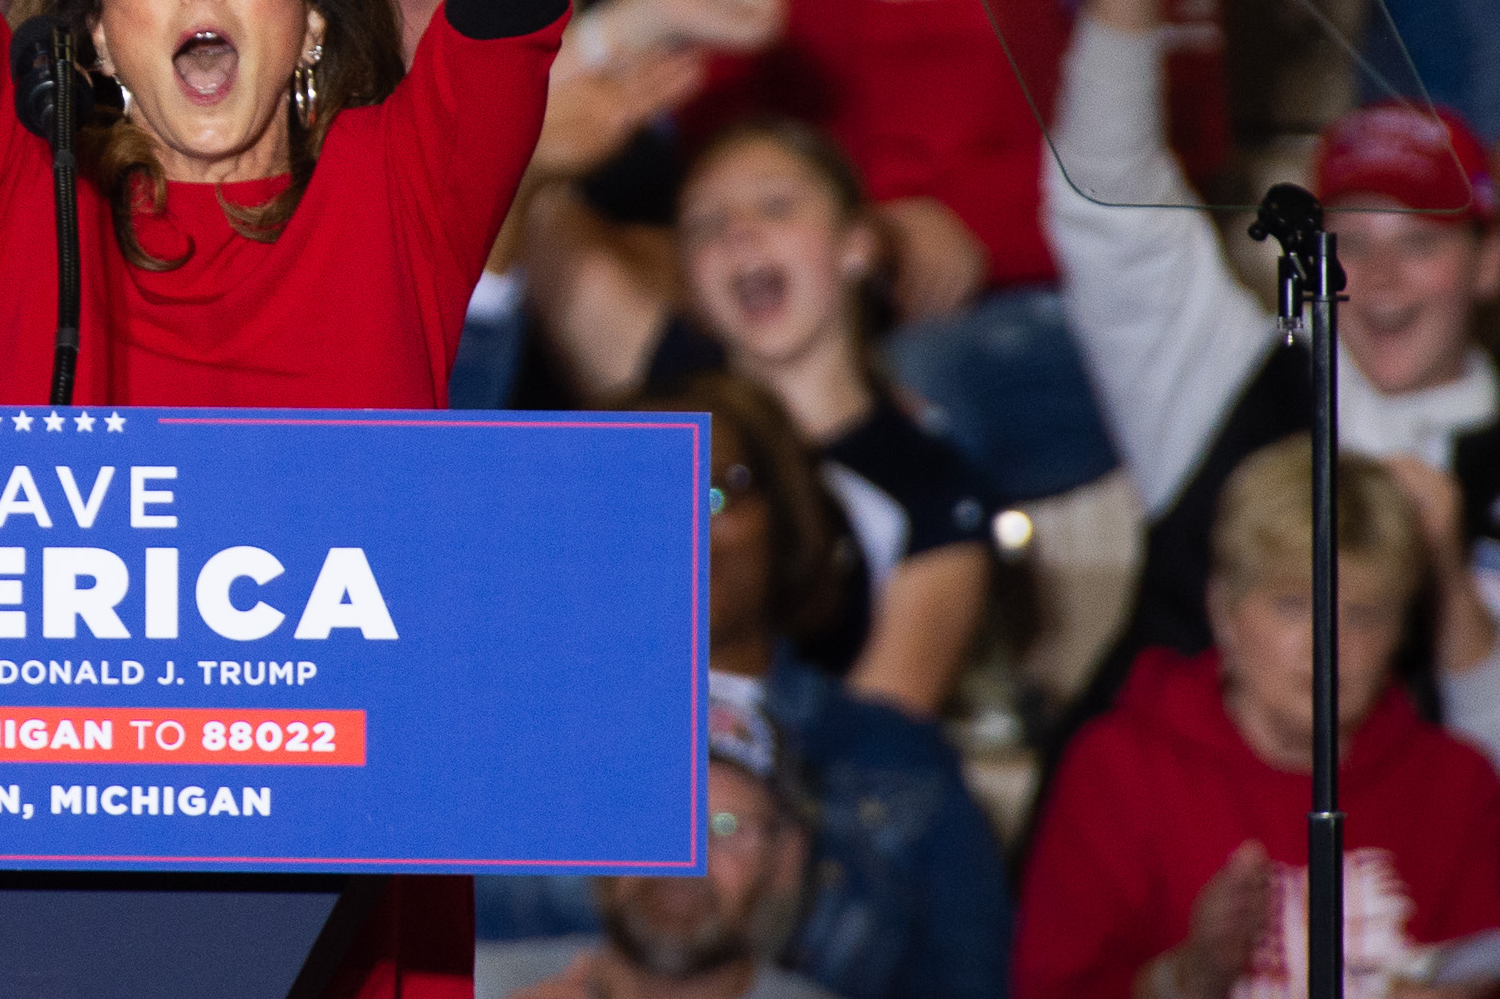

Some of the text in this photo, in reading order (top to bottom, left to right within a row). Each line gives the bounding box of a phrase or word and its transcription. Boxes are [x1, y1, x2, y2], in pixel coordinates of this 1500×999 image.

[157, 660, 186, 687] J.
[197, 660, 319, 687] TRUMP
[129, 720, 187, 752] TO
[201, 720, 337, 754] 88022
[49, 784, 272, 818] MICHIGAN
